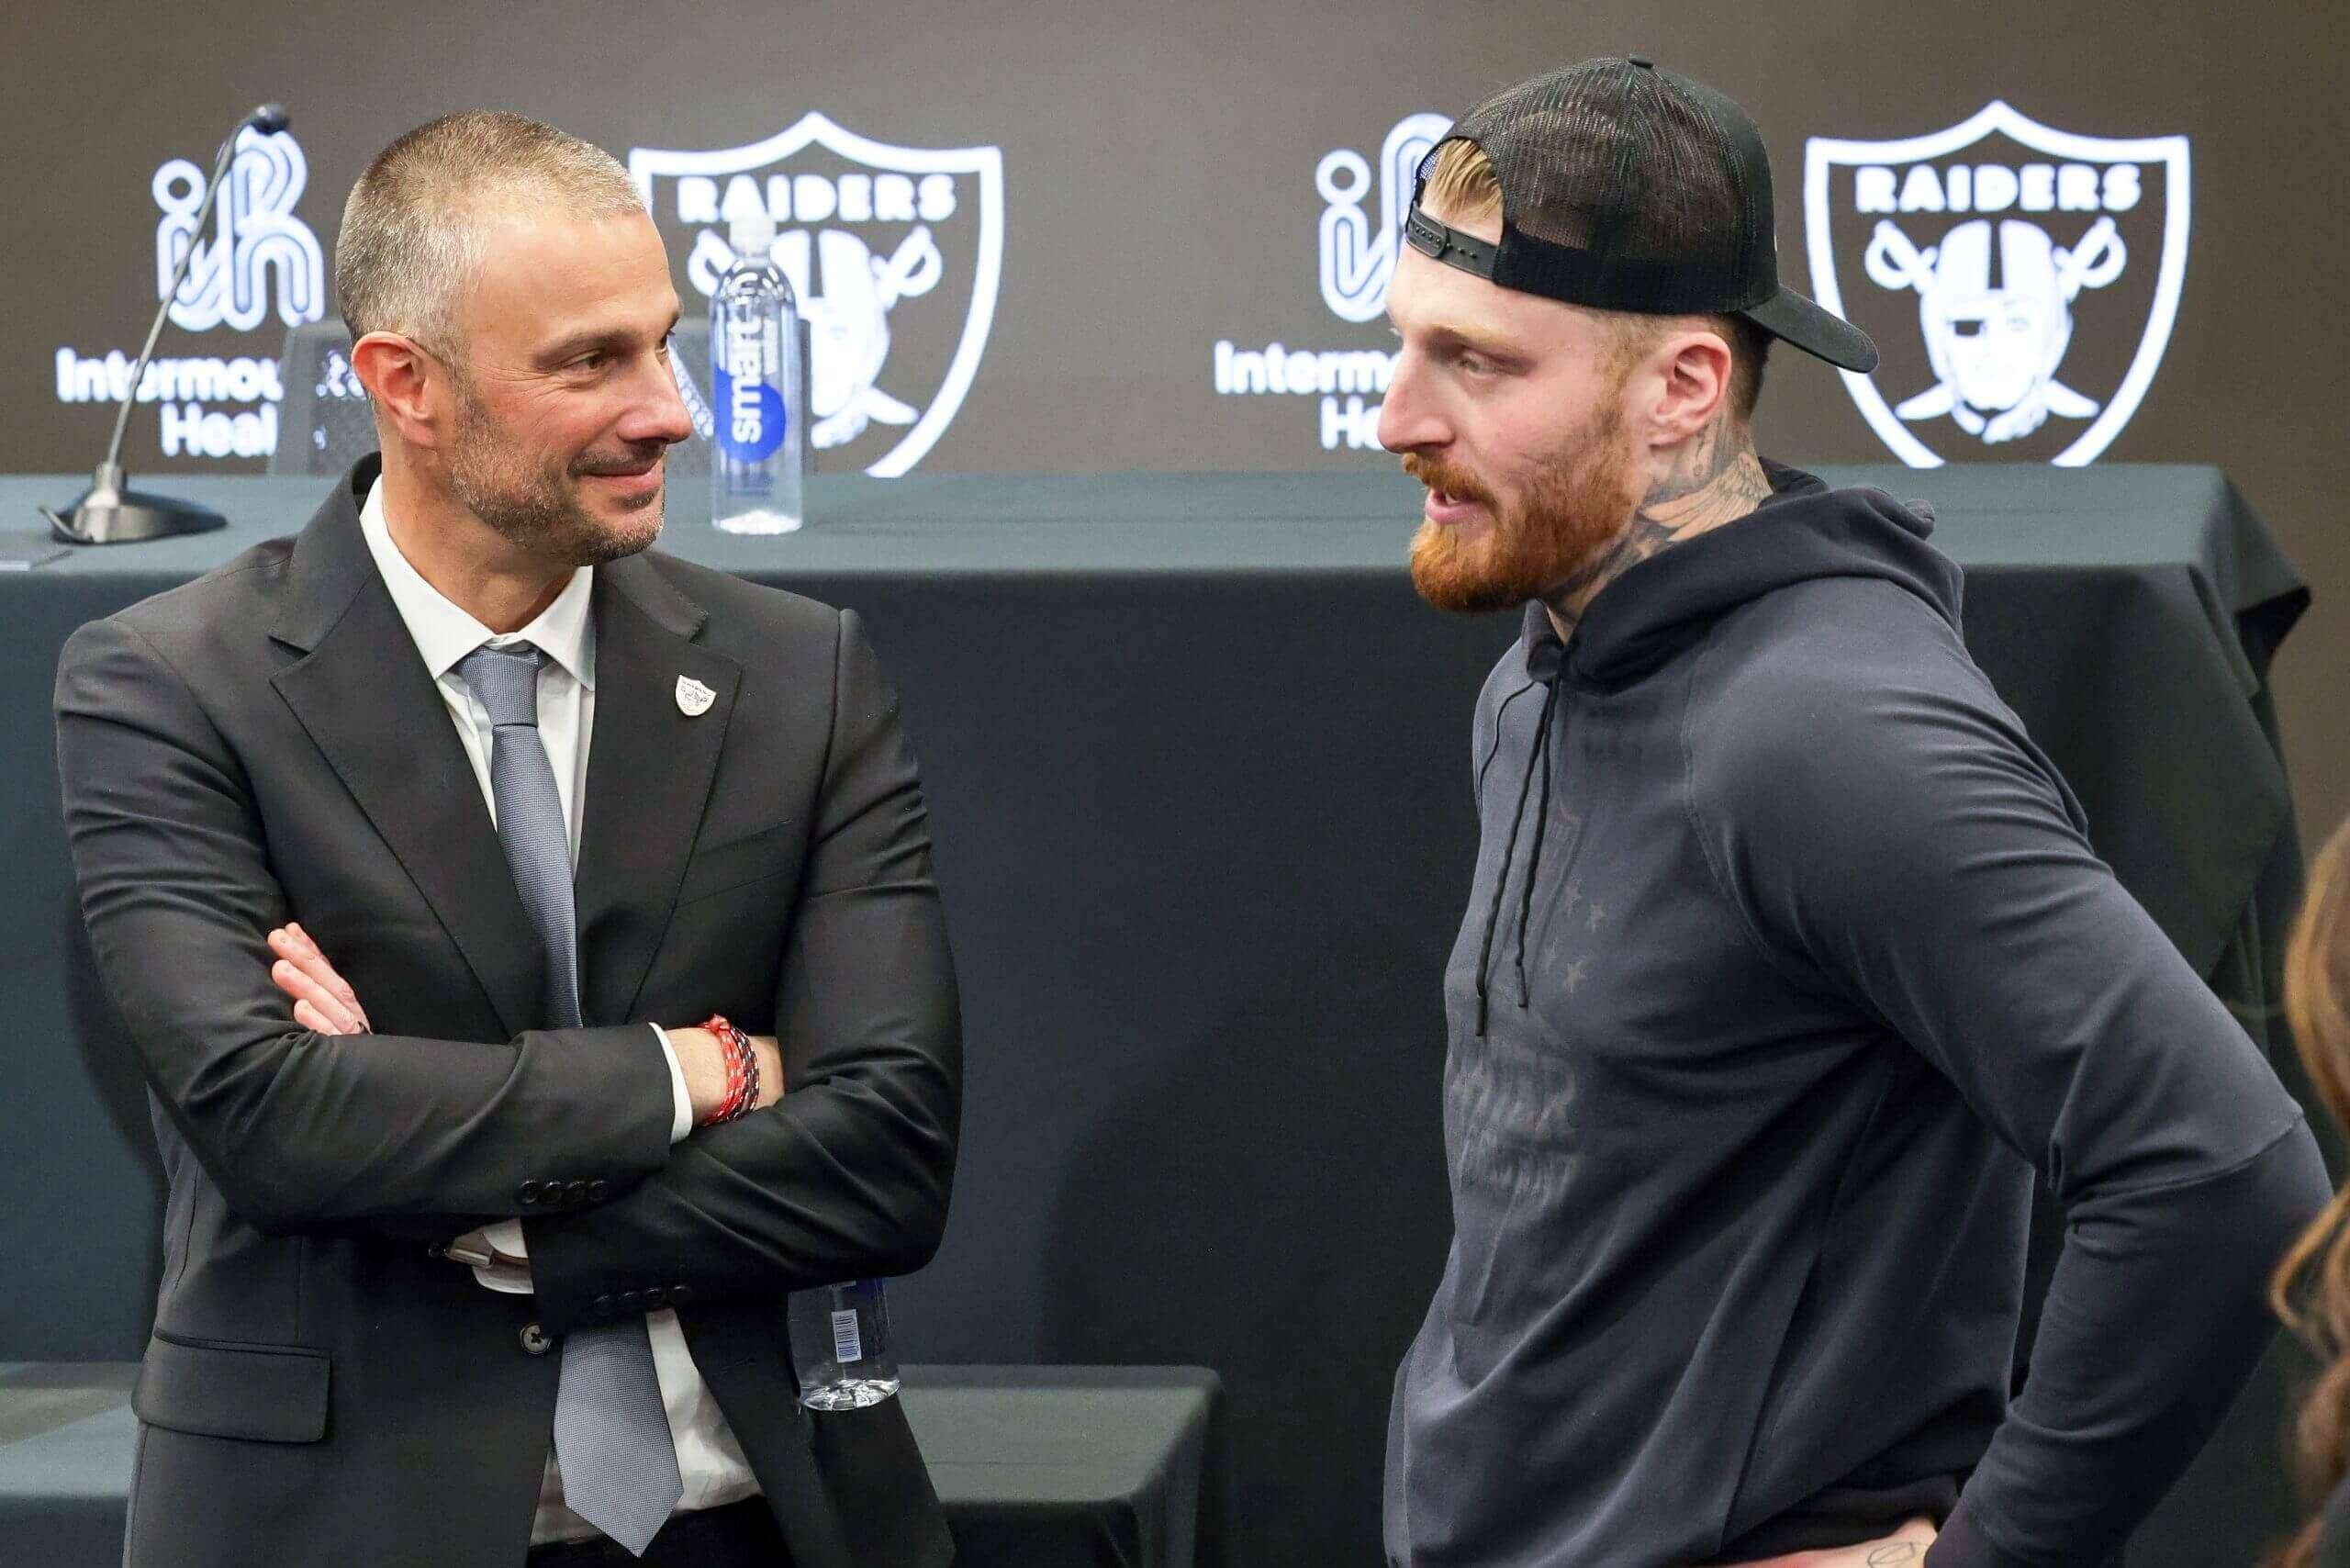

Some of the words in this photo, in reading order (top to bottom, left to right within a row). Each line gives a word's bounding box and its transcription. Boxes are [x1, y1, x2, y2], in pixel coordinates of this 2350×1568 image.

[677, 174, 957, 222] RAIDERS
[1855, 164, 2143, 213] RAIDERS
[1214, 341, 1403, 395] Interm
